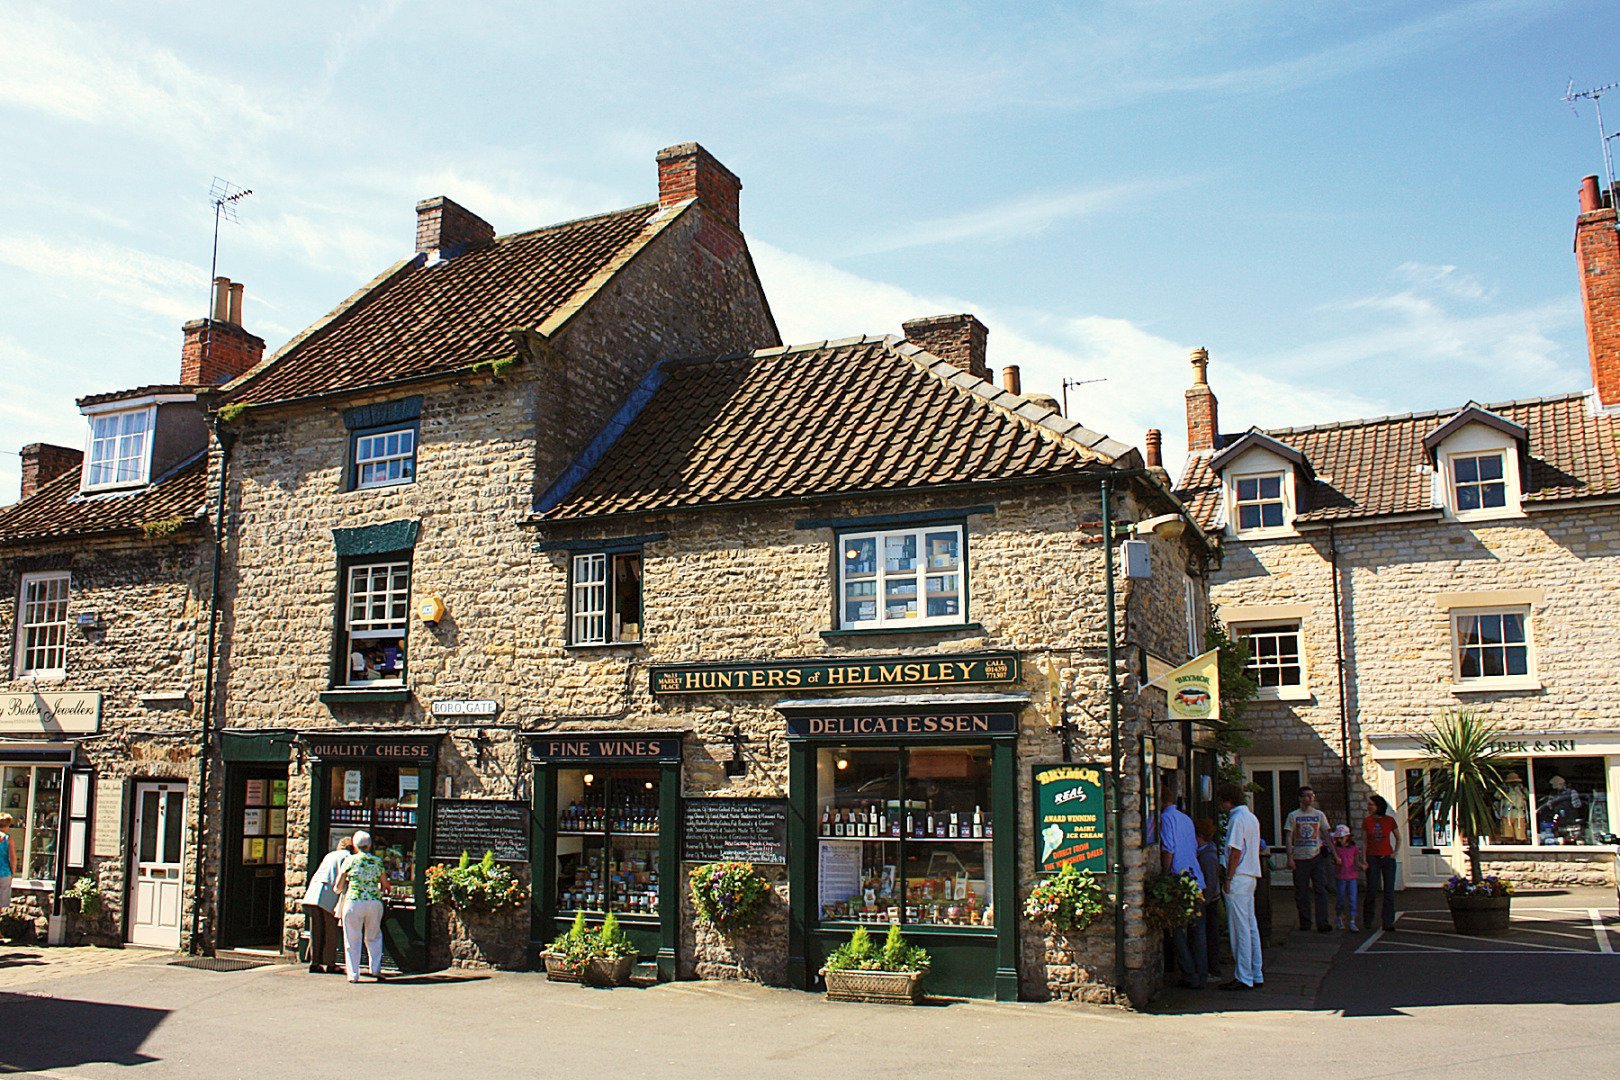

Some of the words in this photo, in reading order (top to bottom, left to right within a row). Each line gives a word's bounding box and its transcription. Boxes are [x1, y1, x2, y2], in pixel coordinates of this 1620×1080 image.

[658, 677, 683, 685] MARKET
[685, 669, 801, 689] HUNTERS
[807, 671, 820, 683] of
[828, 662, 978, 685] HELMSLEY
[1175, 675, 1210, 686] BRYMOR
[43, 697, 94, 723] Jewellers
[434, 703, 462, 713] BORO
[466, 703, 496, 713] GATE
[809, 715, 989, 734] DELICATESSEN
[314, 745, 368, 756] QUALITY
[376, 745, 429, 757] CHEESE
[549, 742, 591, 756] FINE
[599, 741, 660, 756] WINES
[1533, 740, 1546, 752] &
[1549, 739, 1575, 751] SKI
[1036, 767, 1101, 787] BRYMOR
[1055, 786, 1086, 804] REAL
[1044, 815, 1066, 823] AWARD
[1067, 815, 1096, 823] WINNING
[1073, 842, 1089, 853] FROM
[1086, 848, 1103, 859] DALES
